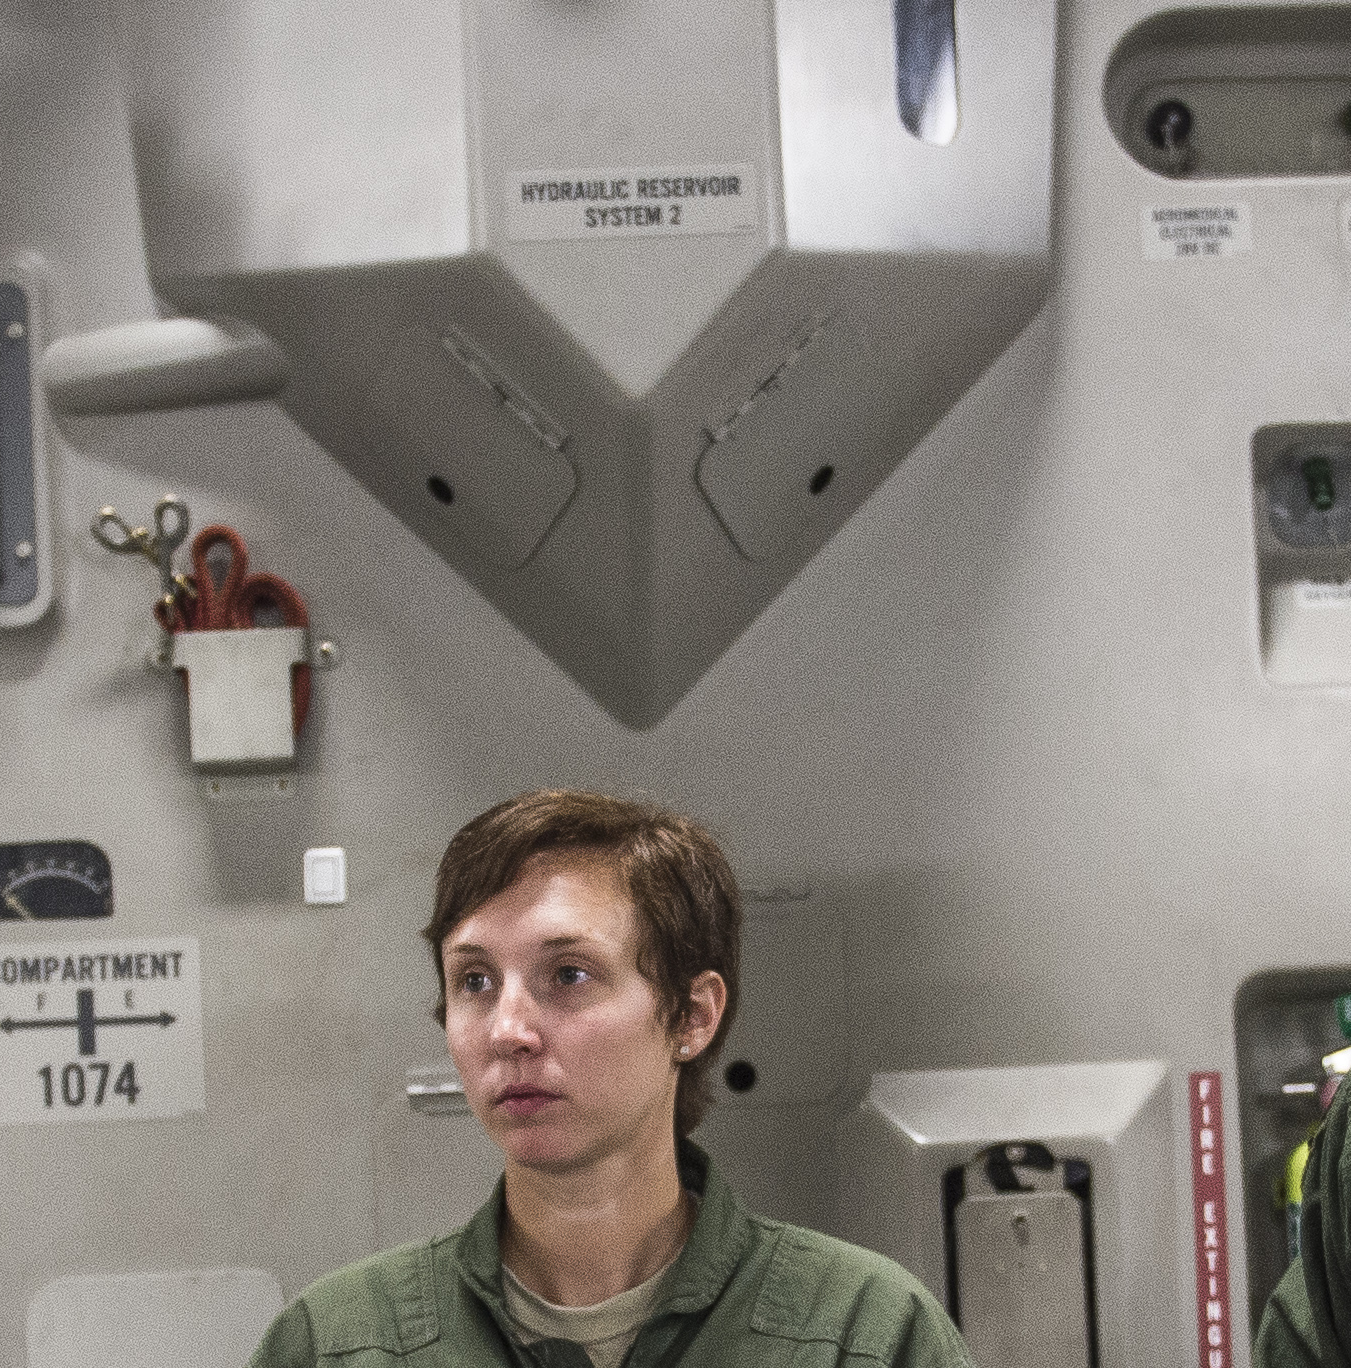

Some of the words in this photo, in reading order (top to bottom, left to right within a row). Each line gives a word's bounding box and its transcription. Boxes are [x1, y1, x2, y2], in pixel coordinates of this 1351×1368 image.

[520, 179, 629, 203] HYDRAULIC
[636, 175, 742, 199] RESERVOIR
[584, 205, 662, 228] SYSTEM
[669, 204, 682, 225] 2
[35, 992, 46, 1011] F
[124, 990, 134, 1009] E
[39, 1061, 140, 1108] 1074
[1198, 1078, 1216, 1176] FIRE
